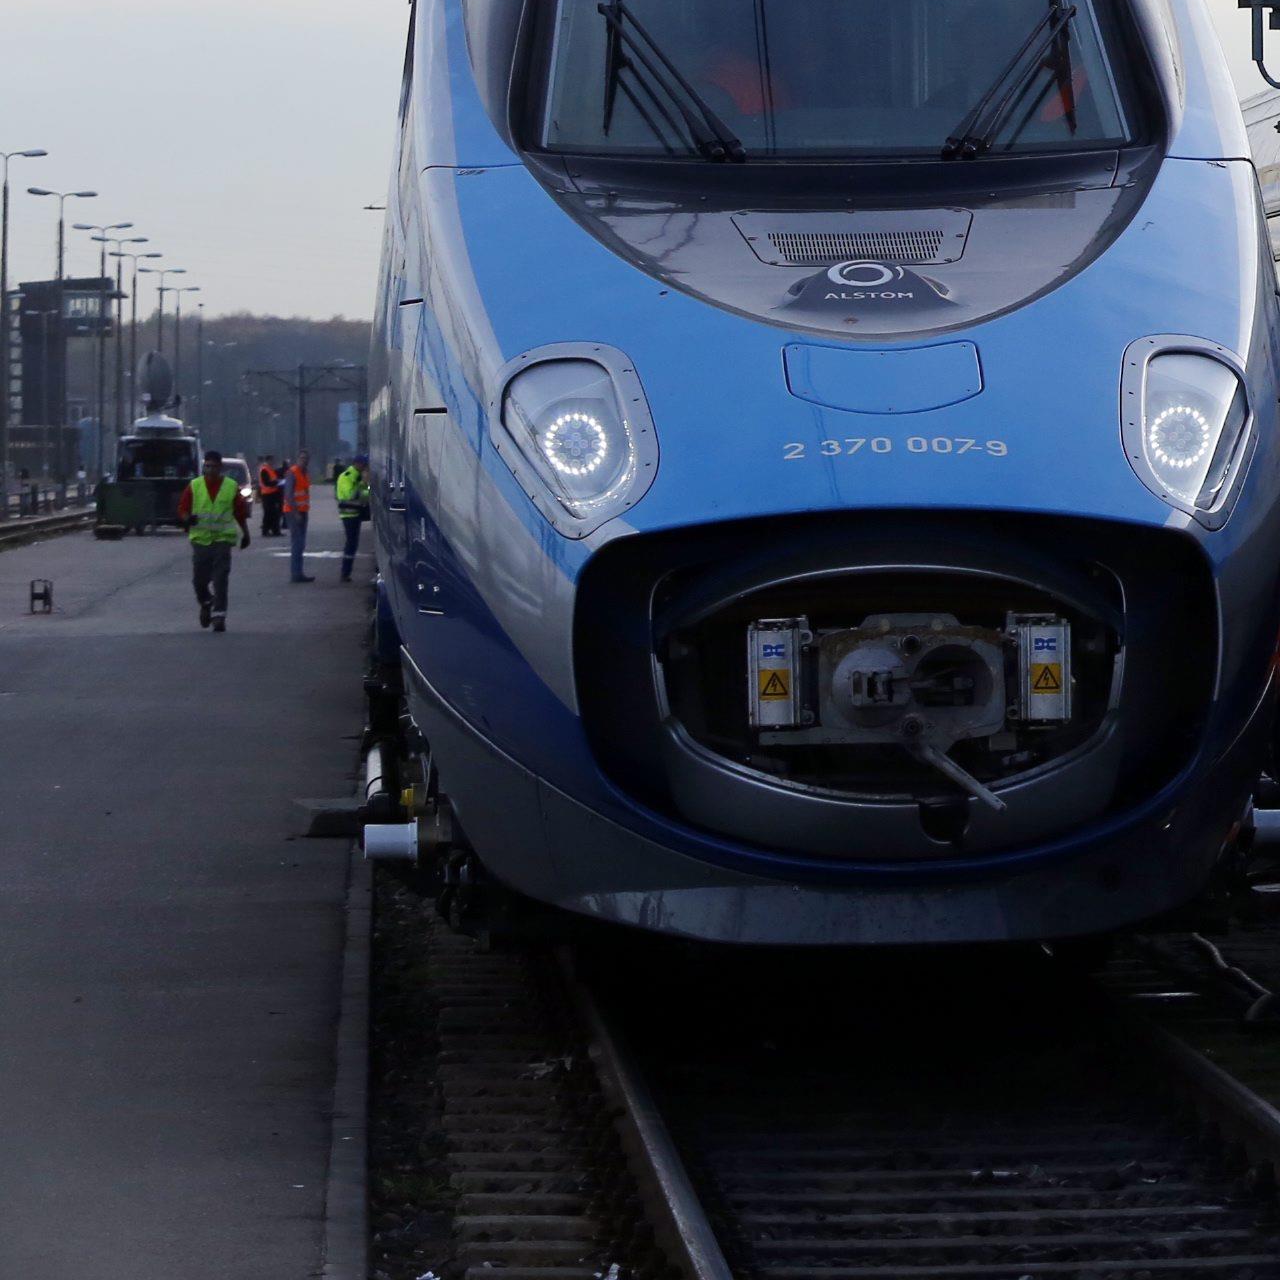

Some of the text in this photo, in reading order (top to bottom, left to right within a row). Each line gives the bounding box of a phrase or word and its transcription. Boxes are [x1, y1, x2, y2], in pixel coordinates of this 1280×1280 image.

[824, 291, 914, 299] ALSTOM
[783, 436, 1009, 460] 2 370 007-9
